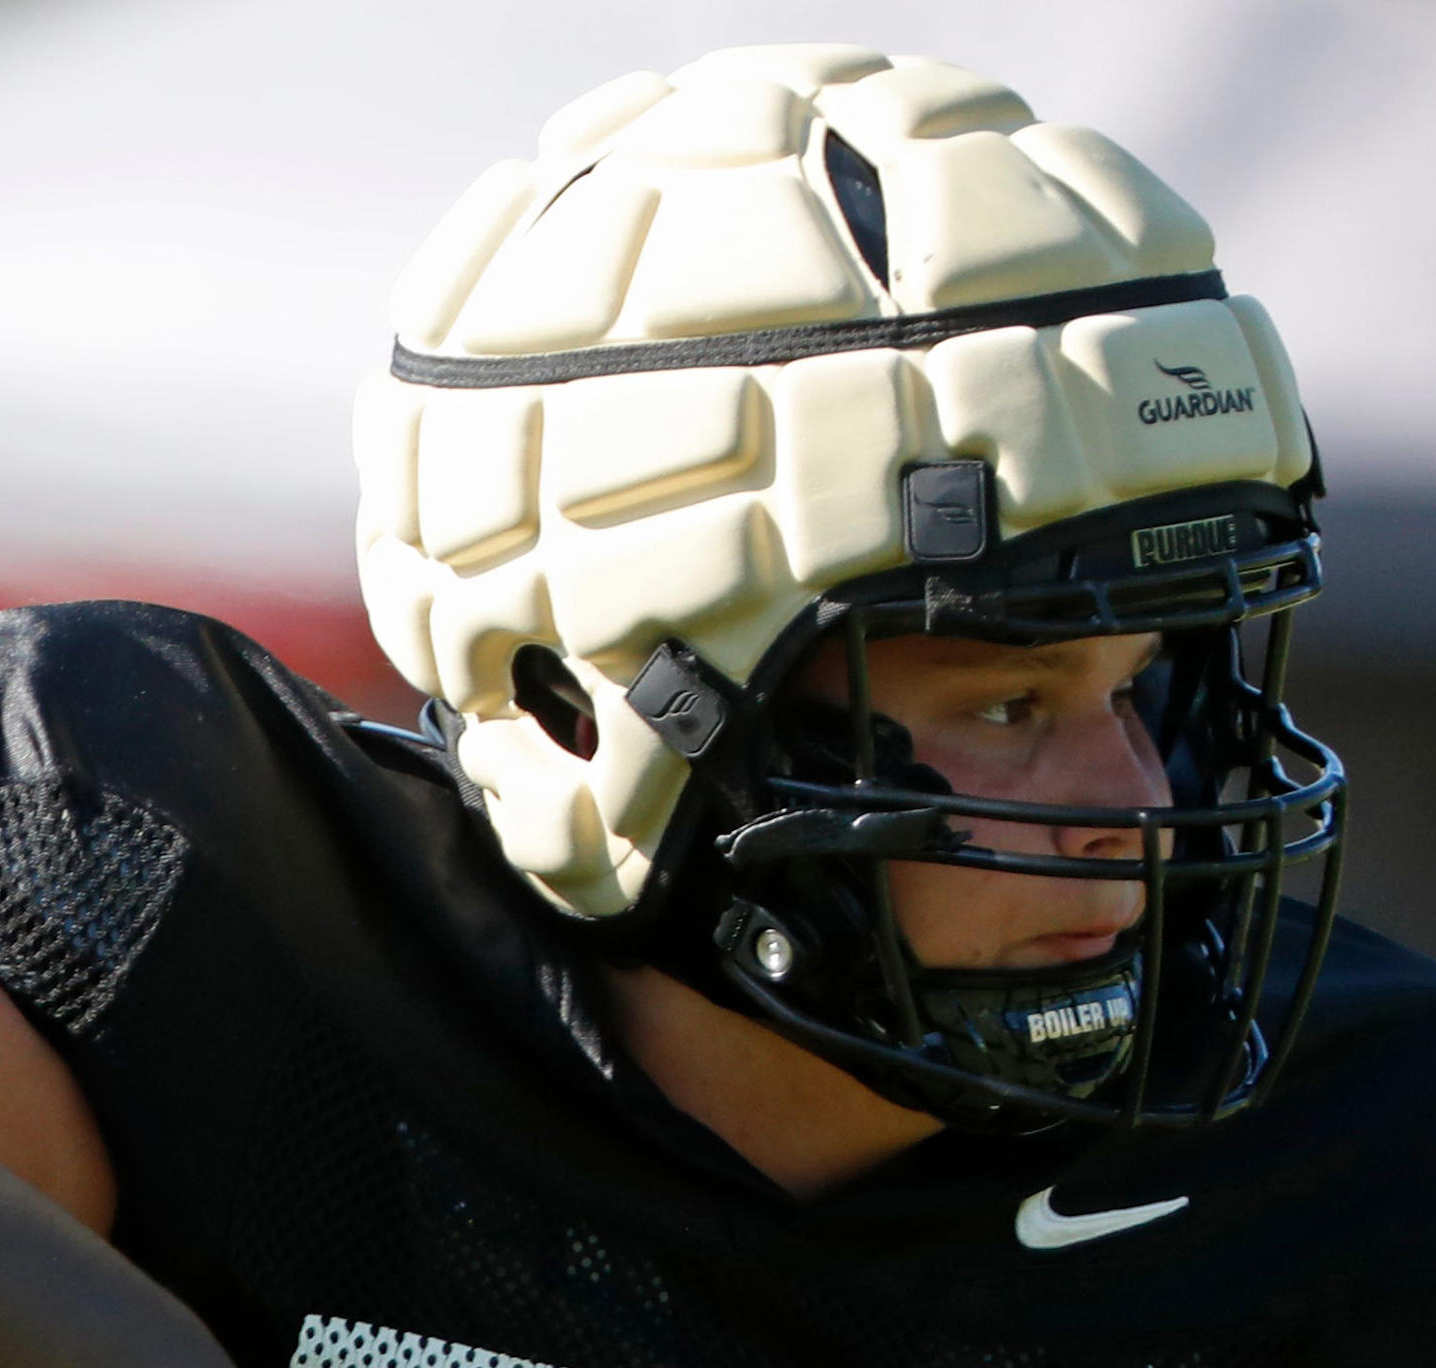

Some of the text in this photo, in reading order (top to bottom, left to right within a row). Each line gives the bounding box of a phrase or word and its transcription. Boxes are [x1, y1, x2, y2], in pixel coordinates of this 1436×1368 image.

[1138, 388, 1254, 425] GUARDIAN
[1131, 513, 1238, 568] PURDUE
[1027, 1002, 1105, 1043] BOILER
